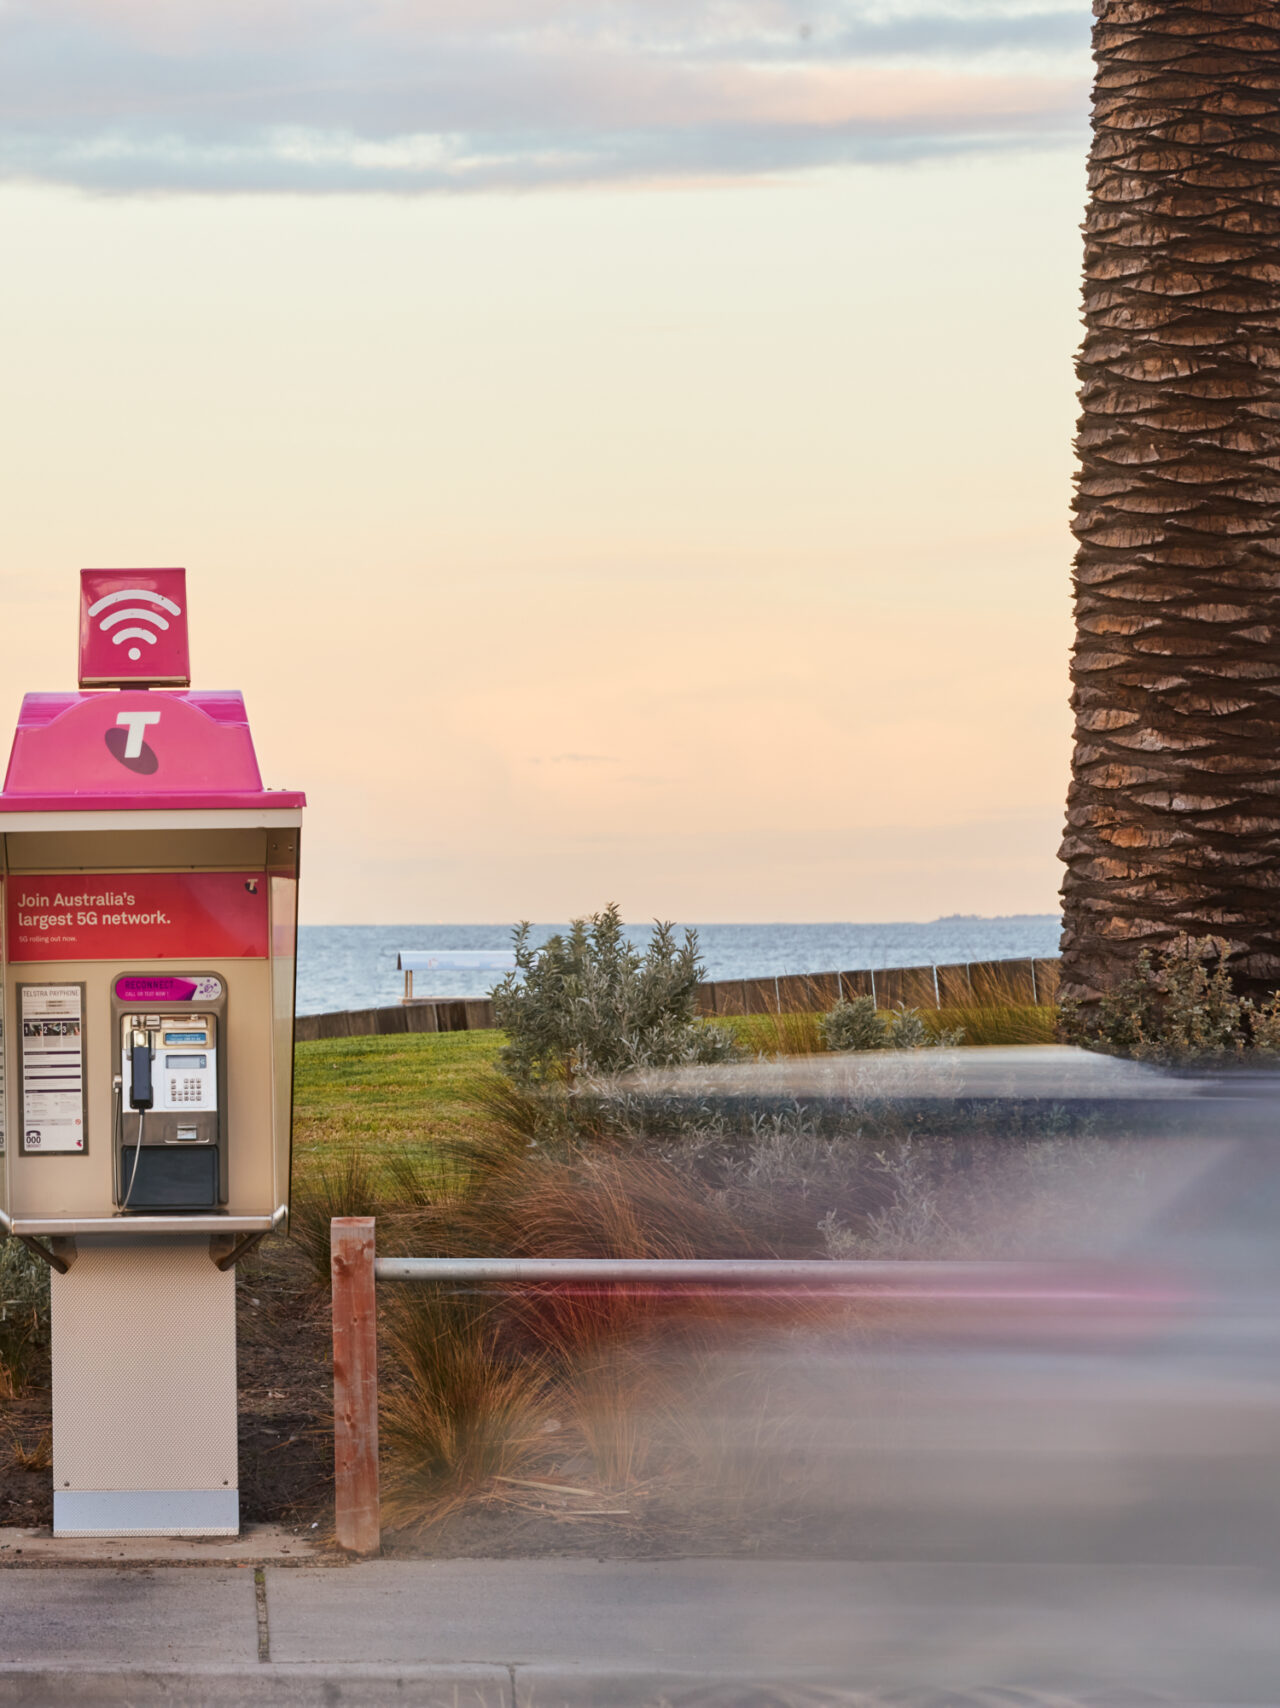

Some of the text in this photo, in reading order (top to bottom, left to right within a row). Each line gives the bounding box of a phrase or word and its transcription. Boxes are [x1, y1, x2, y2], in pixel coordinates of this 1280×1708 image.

[116, 711, 161, 758] T
[17, 892, 136, 908] Join Australia's
[18, 910, 171, 930] largest 5G network.
[29, 935, 50, 943] rolling
[124, 980, 174, 990] RECONNECT
[43, 1026, 48, 1034] 2
[62, 1026, 67, 1034] 3
[26, 1136, 41, 1144] 000
